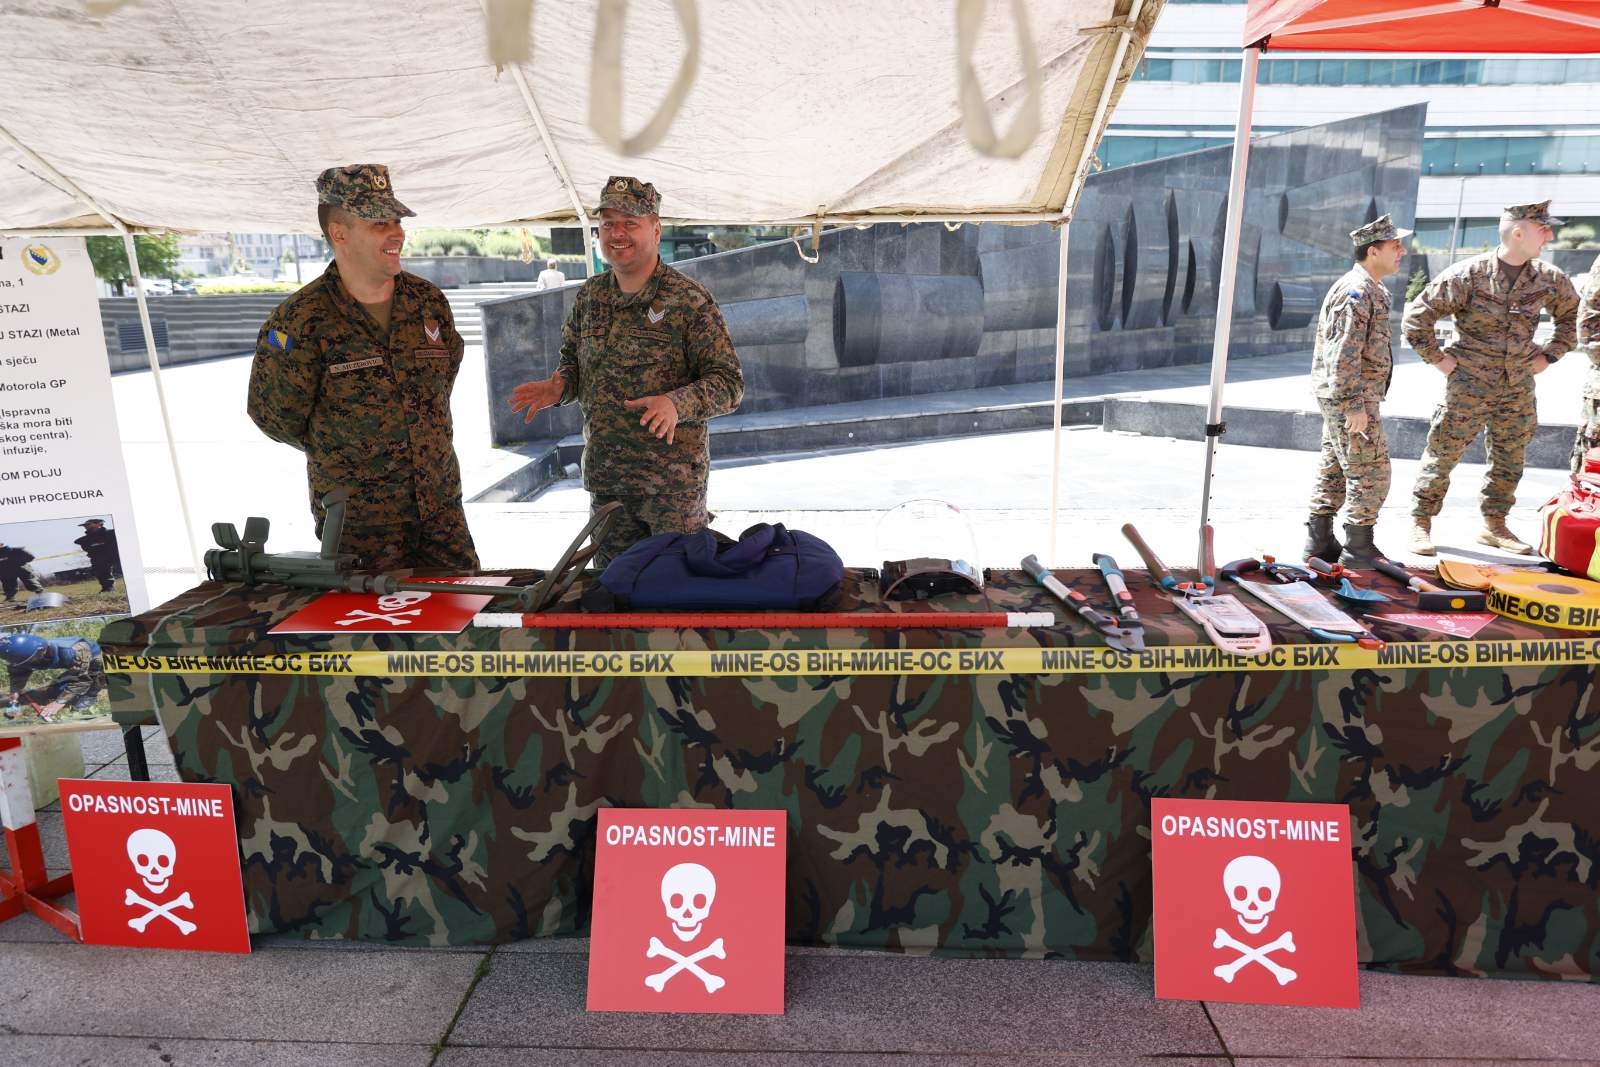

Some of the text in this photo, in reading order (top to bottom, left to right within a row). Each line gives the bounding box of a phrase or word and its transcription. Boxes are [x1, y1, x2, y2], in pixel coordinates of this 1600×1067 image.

[18, 277, 24, 286] 1
[0, 303, 30, 314] STAZI
[8, 329, 42, 339] STAZI
[46, 327, 80, 339] (Metal
[5, 356, 37, 367] sječu
[0, 379, 67, 391] Motorola GP
[0, 407, 51, 418] Ispravna
[23, 420, 52, 429] mora
[55, 417, 73, 426] biti
[30, 430, 72, 440] centra).
[0, 468, 62, 481] OM POLJU
[29, 489, 104, 503] PROCEDURA
[309, 654, 352, 672] БИХ
[387, 654, 475, 673] MINE-OS
[629, 653, 675, 673] БИХ
[710, 652, 800, 673] MINE-OS
[959, 650, 1005, 671] БИХ
[1041, 649, 1132, 670] MINE-OS
[1293, 646, 1339, 667] БИХ
[1377, 643, 1470, 665] MINE-OS
[68, 793, 224, 818] OPASNOST-MINE
[1161, 815, 1340, 842] OPASNOST-MINE
[606, 824, 776, 847] OPASNOST-MINE
